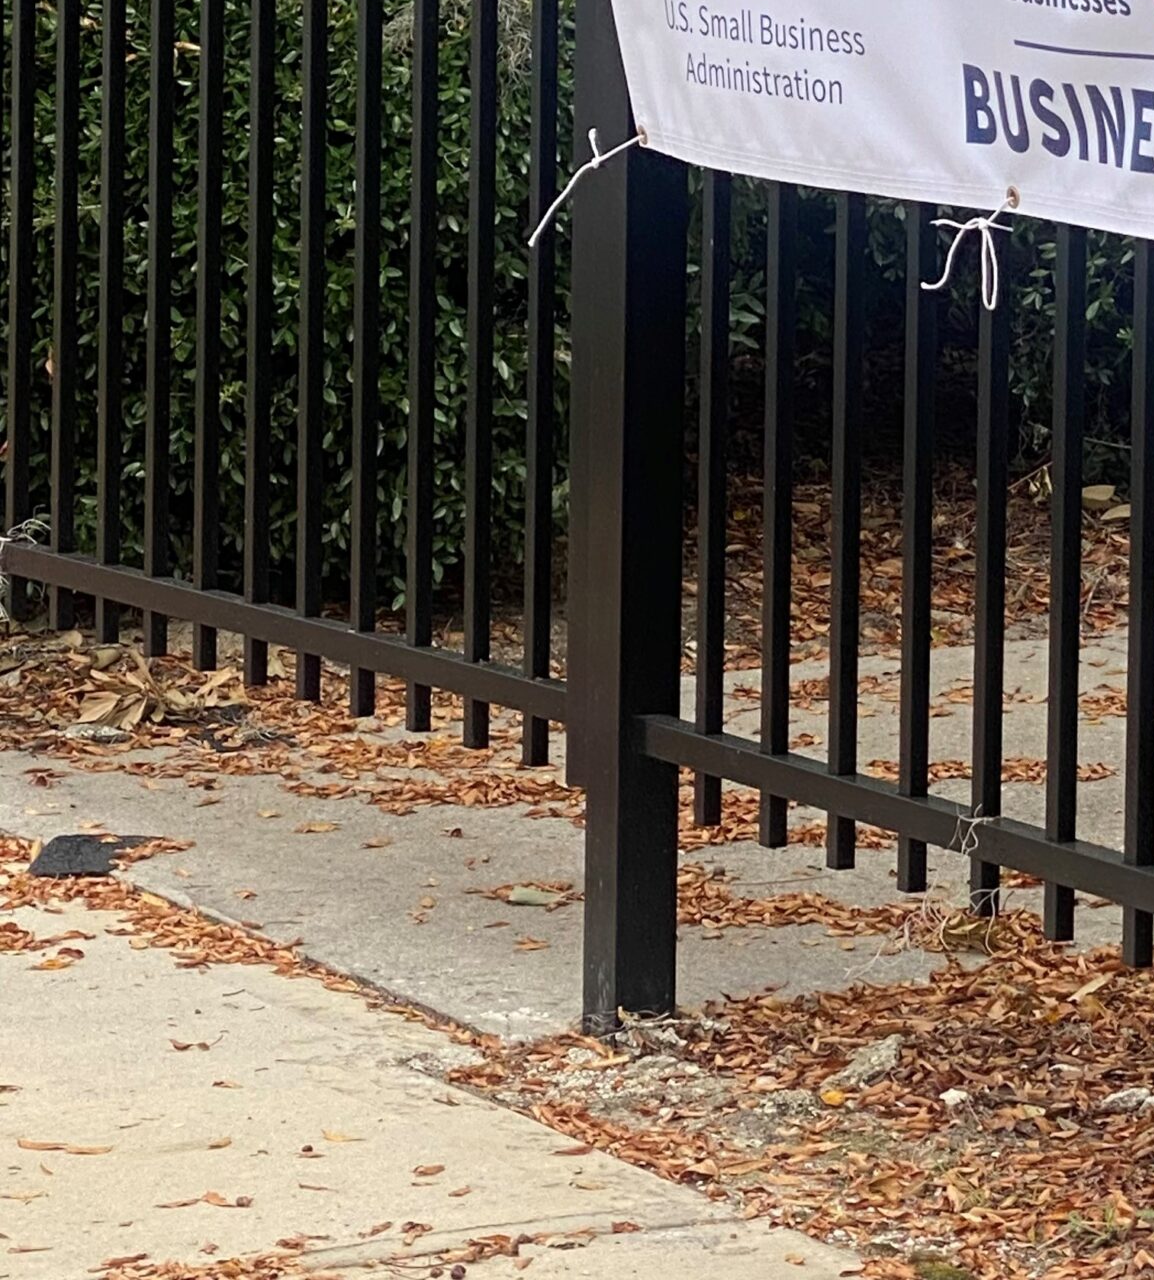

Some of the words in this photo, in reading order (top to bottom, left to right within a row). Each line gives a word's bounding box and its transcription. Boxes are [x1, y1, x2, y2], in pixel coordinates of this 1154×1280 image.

[664, 0, 693, 34] U.S.
[699, 5, 753, 44] Small
[760, 13, 865, 56] Business
[686, 51, 842, 105] Administration
